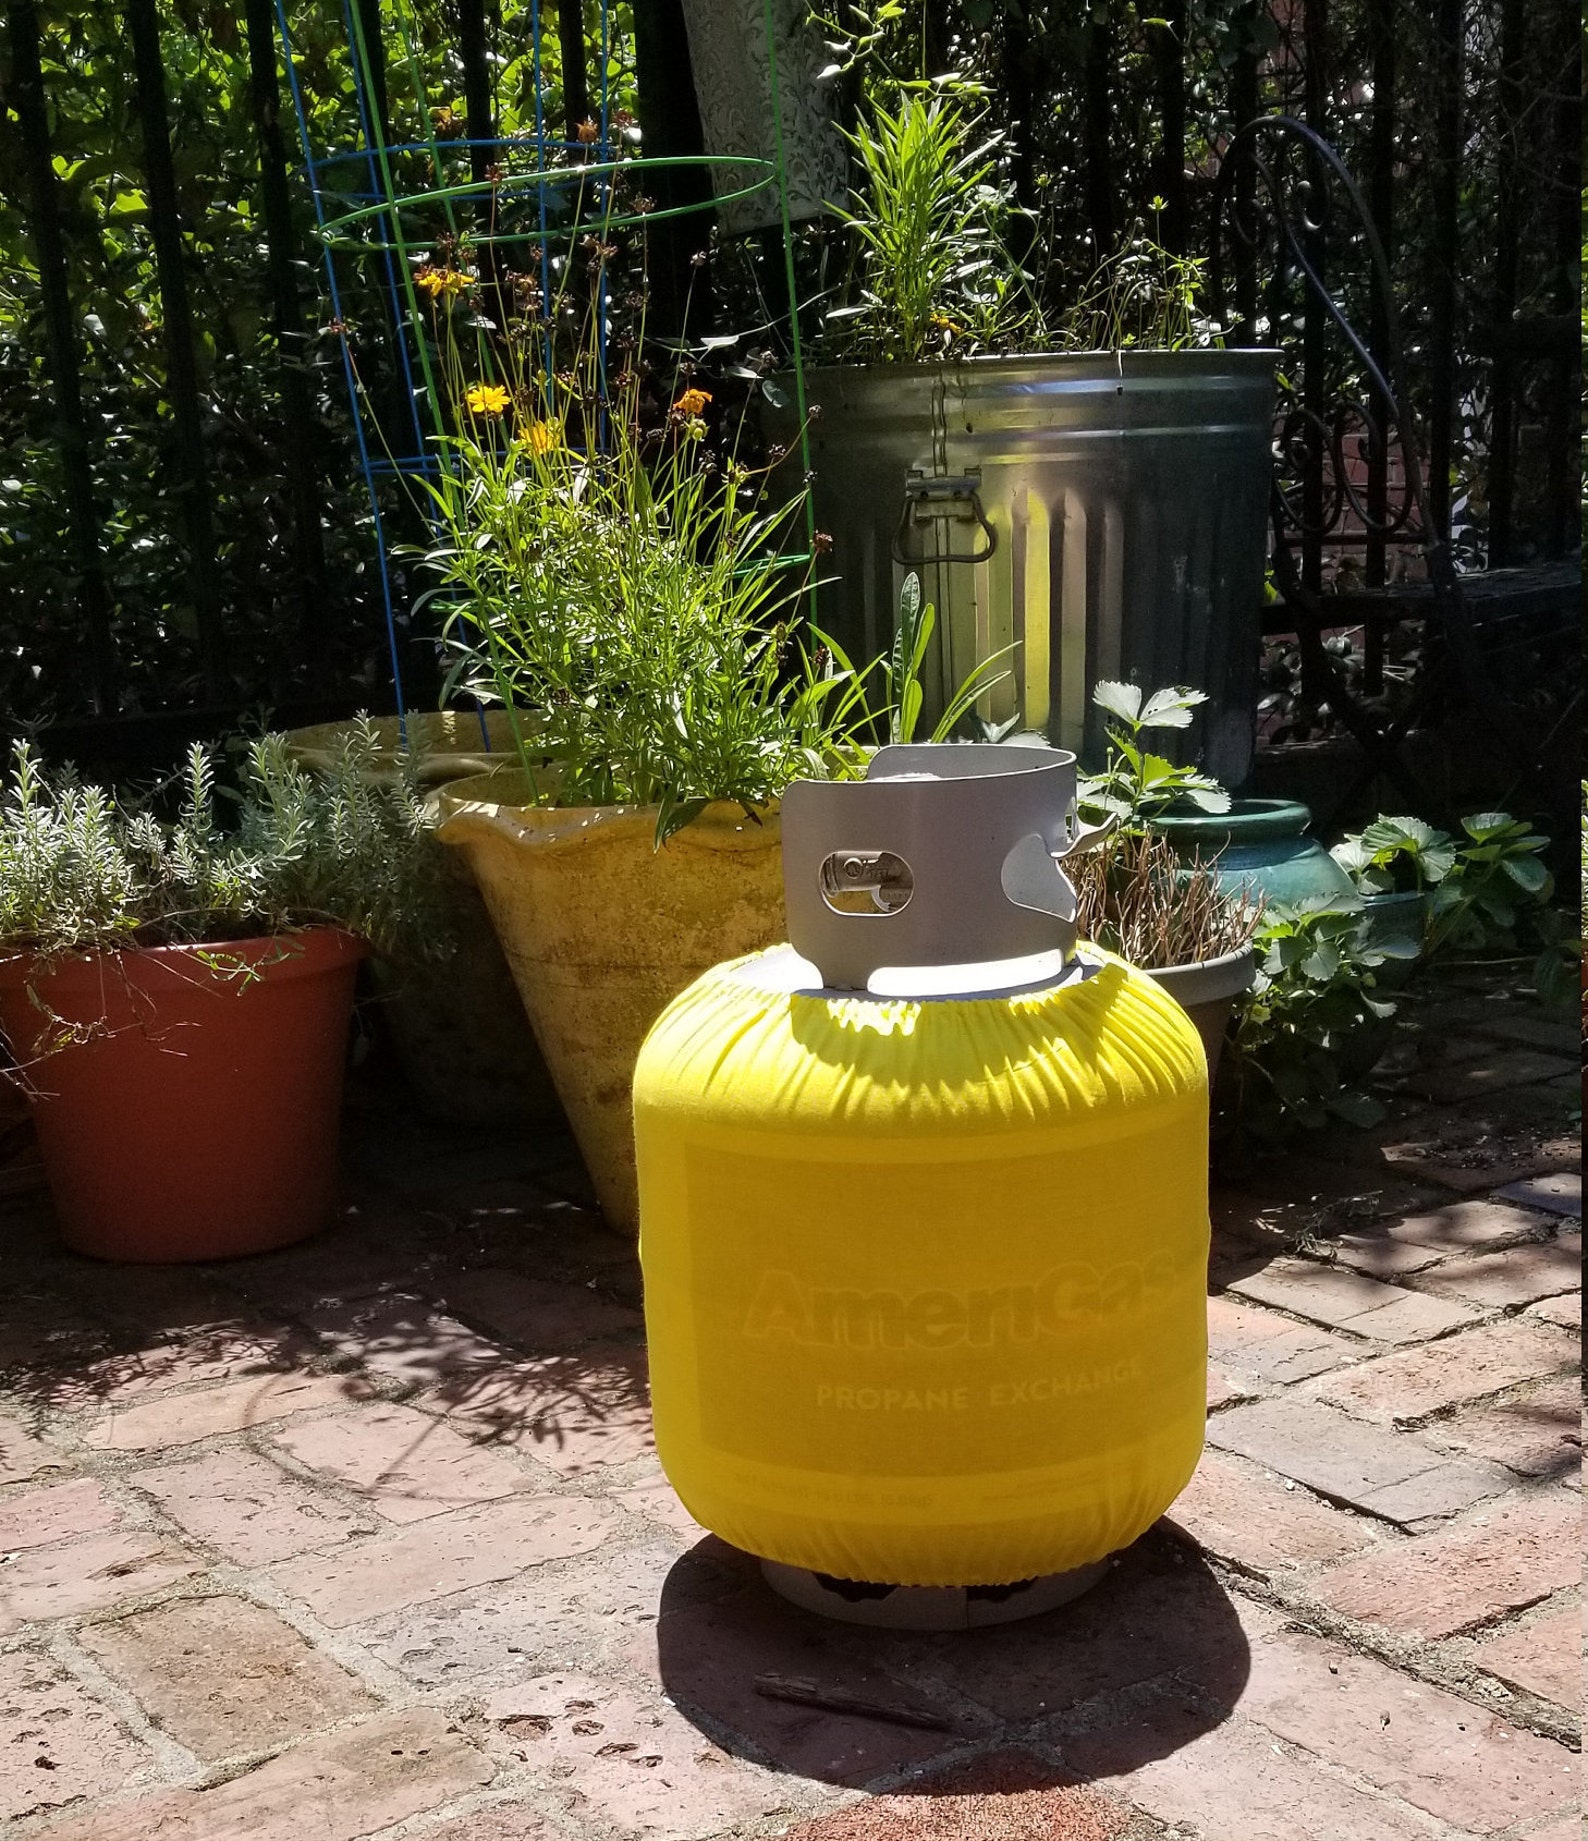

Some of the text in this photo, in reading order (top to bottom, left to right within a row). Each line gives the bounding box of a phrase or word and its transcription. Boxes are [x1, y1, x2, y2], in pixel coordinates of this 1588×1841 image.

[742, 1248, 1178, 1351] AmeriGas
[816, 1356, 1144, 1412] PROPANE EXCHANGE
